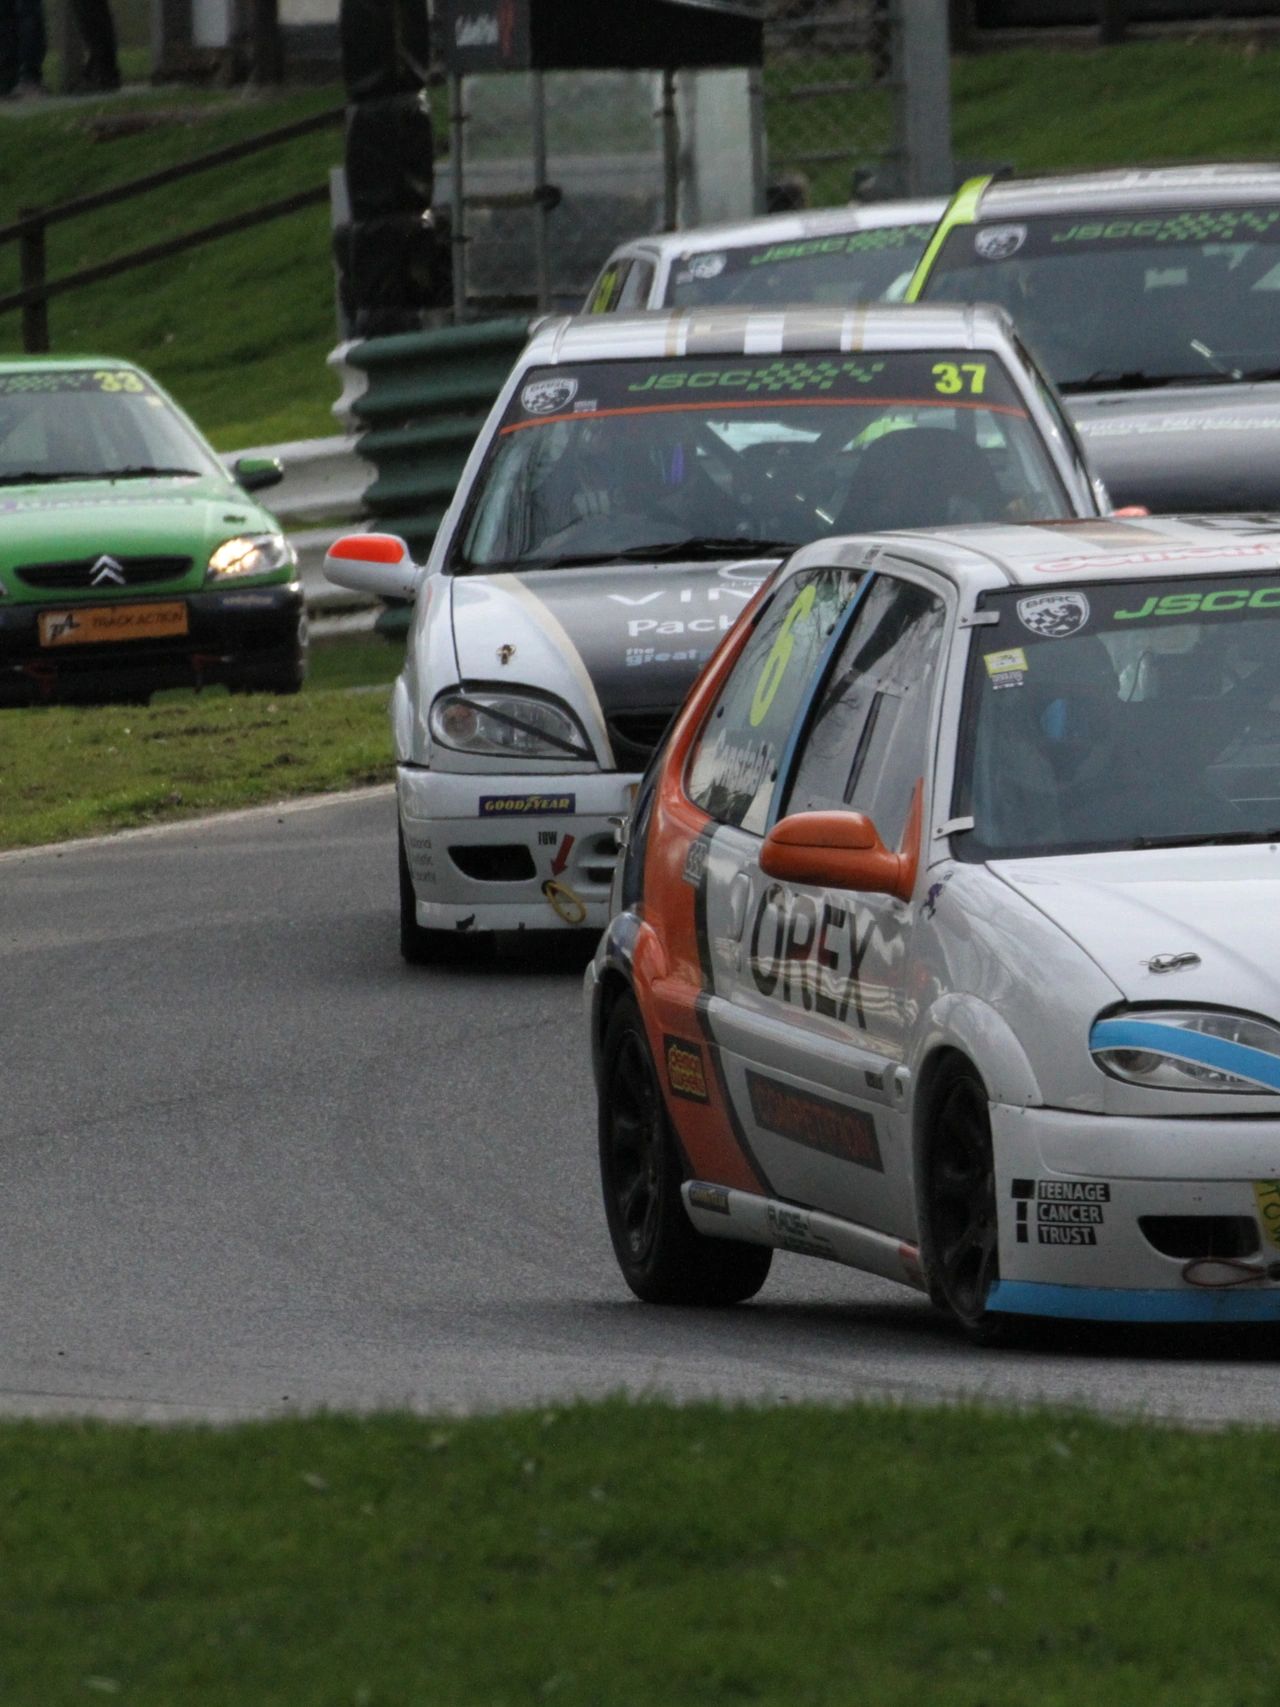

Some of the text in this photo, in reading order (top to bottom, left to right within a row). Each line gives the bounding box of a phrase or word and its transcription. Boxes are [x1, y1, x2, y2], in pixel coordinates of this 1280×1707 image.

[1051, 218, 1162, 243] JSCC
[93, 371, 145, 392] 33
[627, 368, 756, 392] JSCC
[931, 362, 987, 394] 37
[1025, 593, 1079, 608] BARC
[484, 794, 571, 811] GOODYEAR
[1039, 1181, 1106, 1201] TEENAGE
[1039, 1203, 1102, 1222] CANCER
[1040, 1225, 1093, 1244] TRUST
